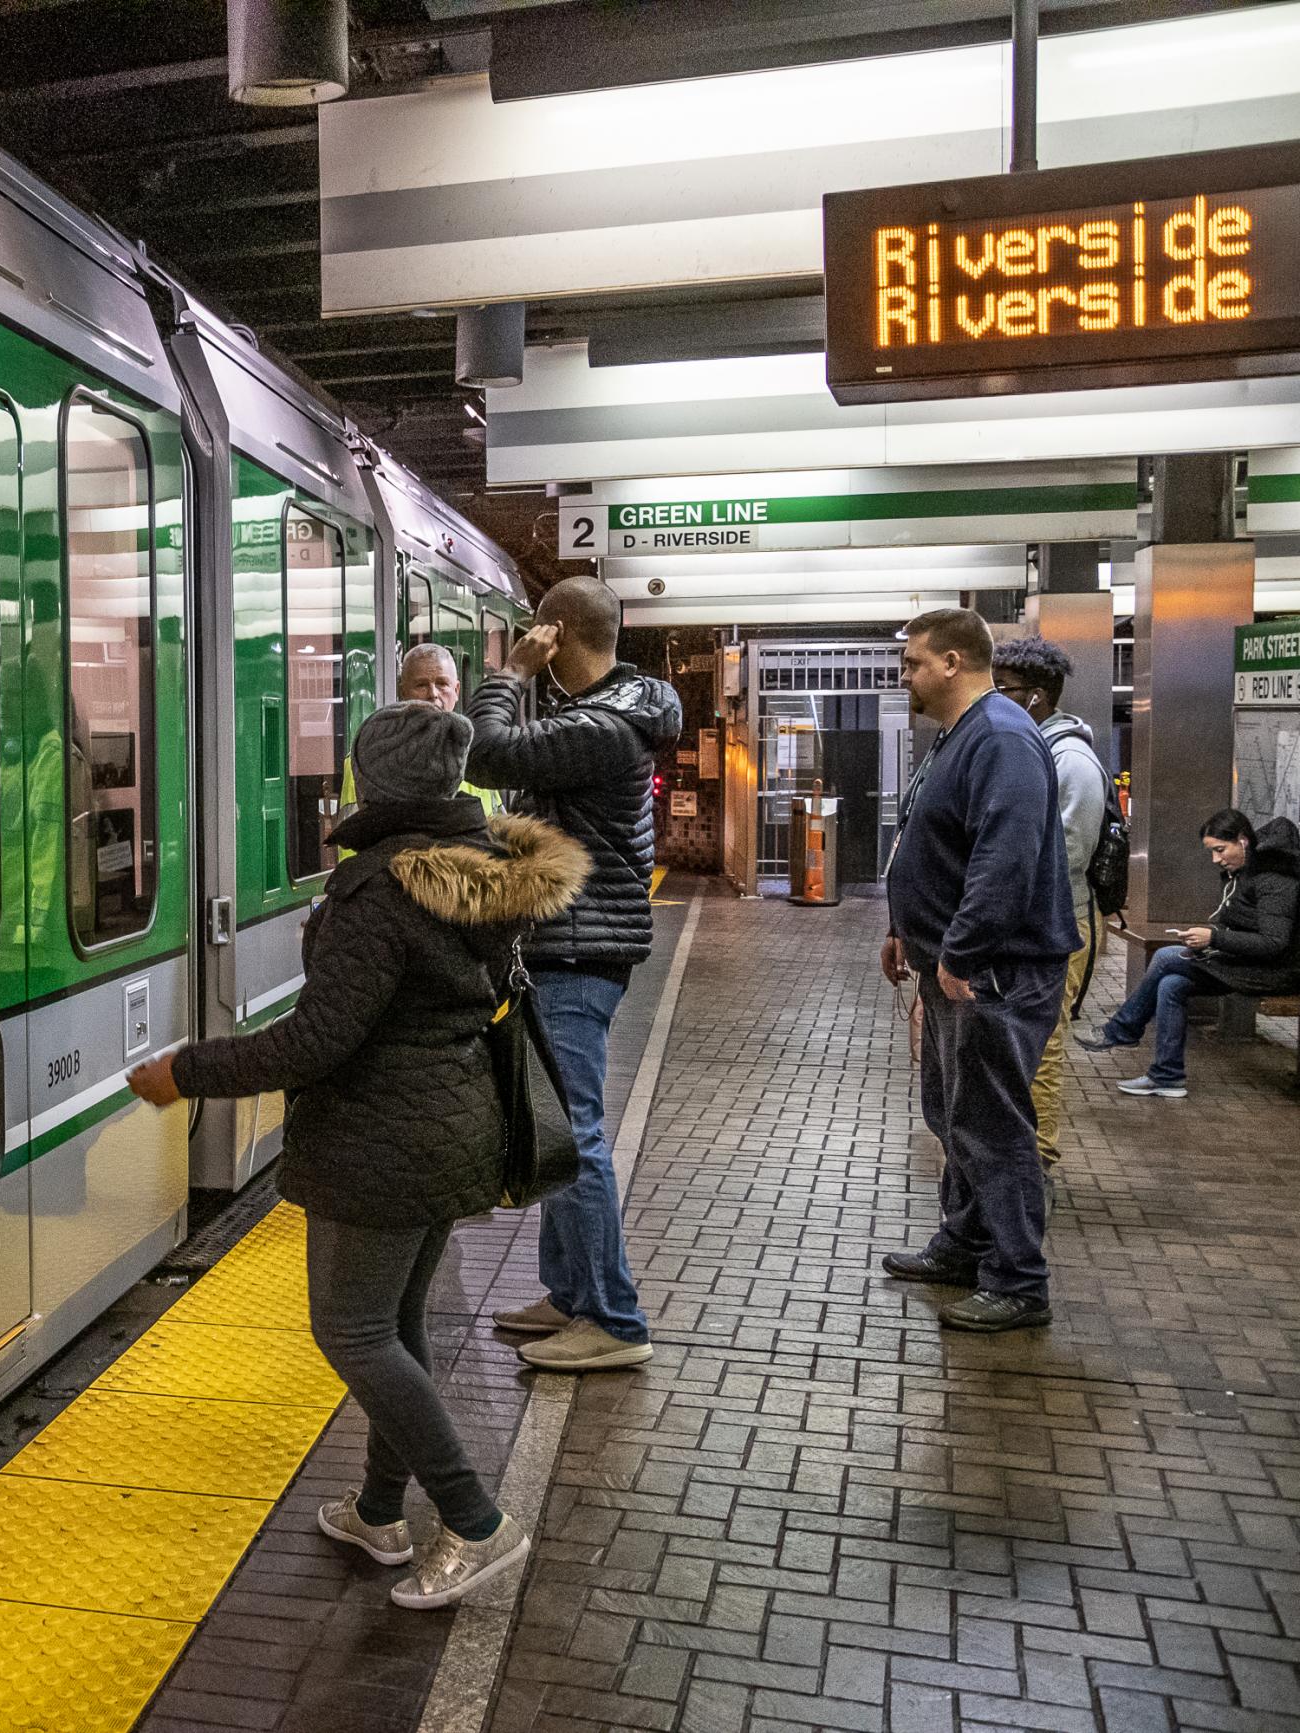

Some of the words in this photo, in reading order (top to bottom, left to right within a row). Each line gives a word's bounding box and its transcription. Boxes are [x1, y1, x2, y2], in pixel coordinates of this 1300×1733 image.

[875, 194, 1252, 287] Riverside
[877, 257, 1252, 348] Riverside
[619, 503, 703, 527] GREEN
[712, 501, 768, 523] LINE
[572, 517, 595, 548] 2
[623, 534, 636, 548] D
[654, 530, 751, 547] RIVERSIDE
[1243, 636, 1265, 660] PARK
[790, 657, 811, 666] EXIT
[1252, 676, 1270, 699] RED
[1272, 675, 1293, 699] LINE
